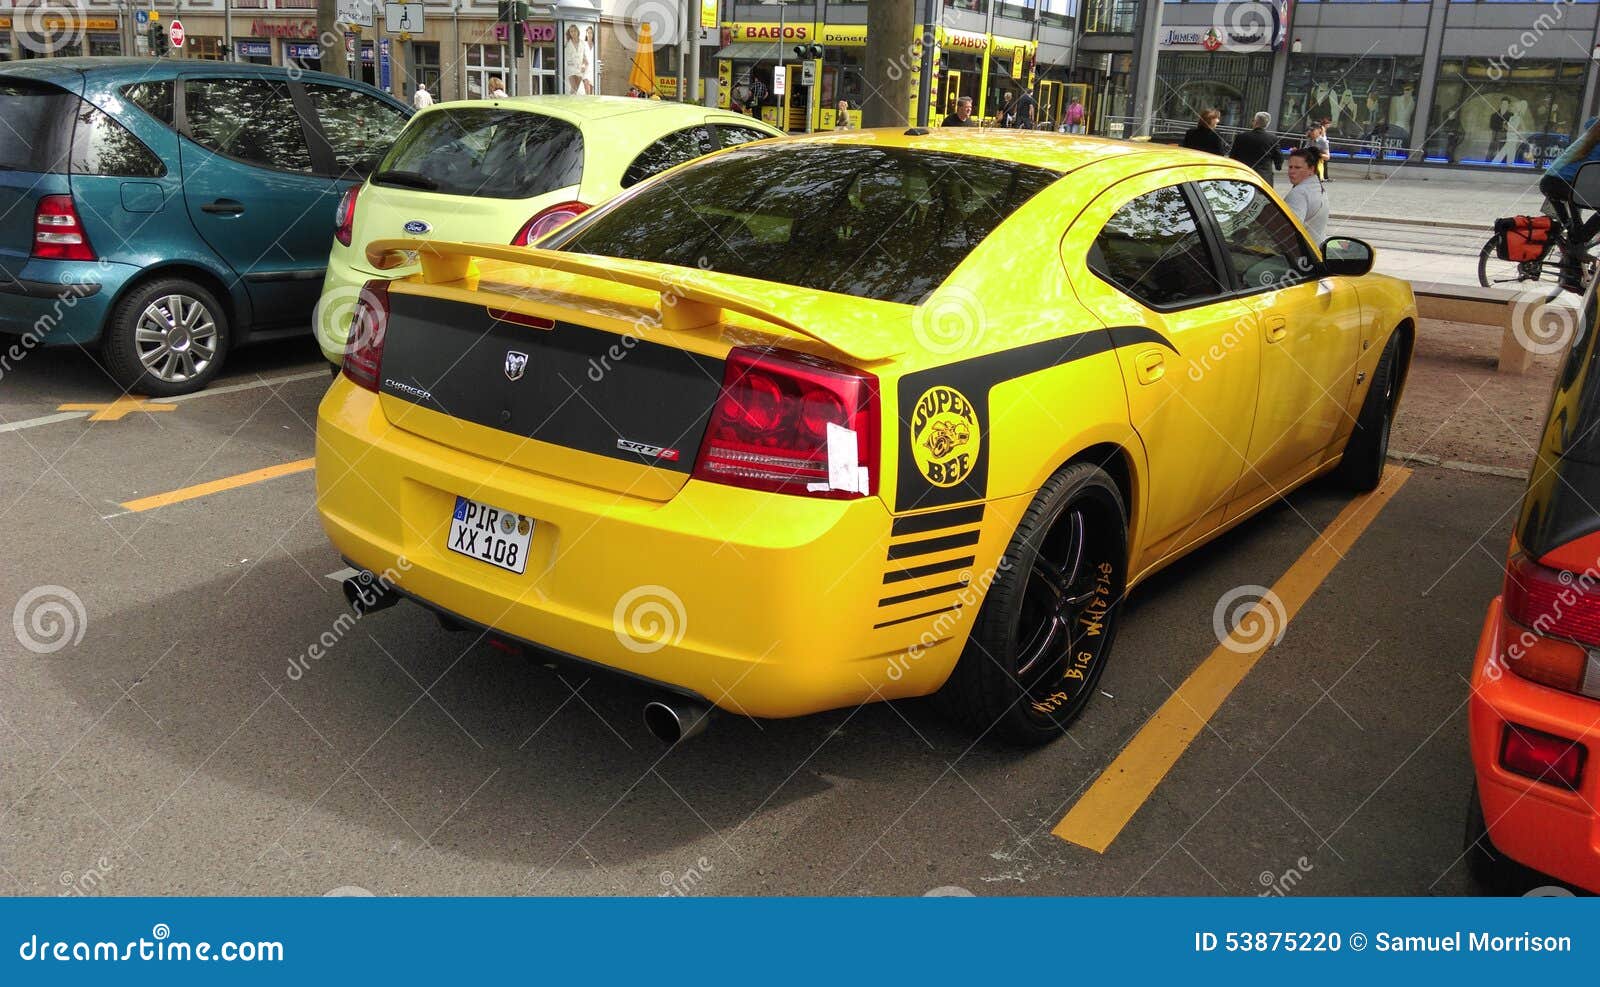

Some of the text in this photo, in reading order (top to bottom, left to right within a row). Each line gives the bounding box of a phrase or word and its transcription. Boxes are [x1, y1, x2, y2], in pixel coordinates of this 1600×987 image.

[171, 29, 184, 38] STOP
[746, 26, 807, 40] BABOS
[952, 35, 988, 50] BABOS
[385, 379, 431, 400] CHARGER
[915, 389, 974, 443] SUPER
[927, 453, 970, 484] BEE
[465, 501, 499, 534] PIR
[455, 525, 519, 567] XX 108
